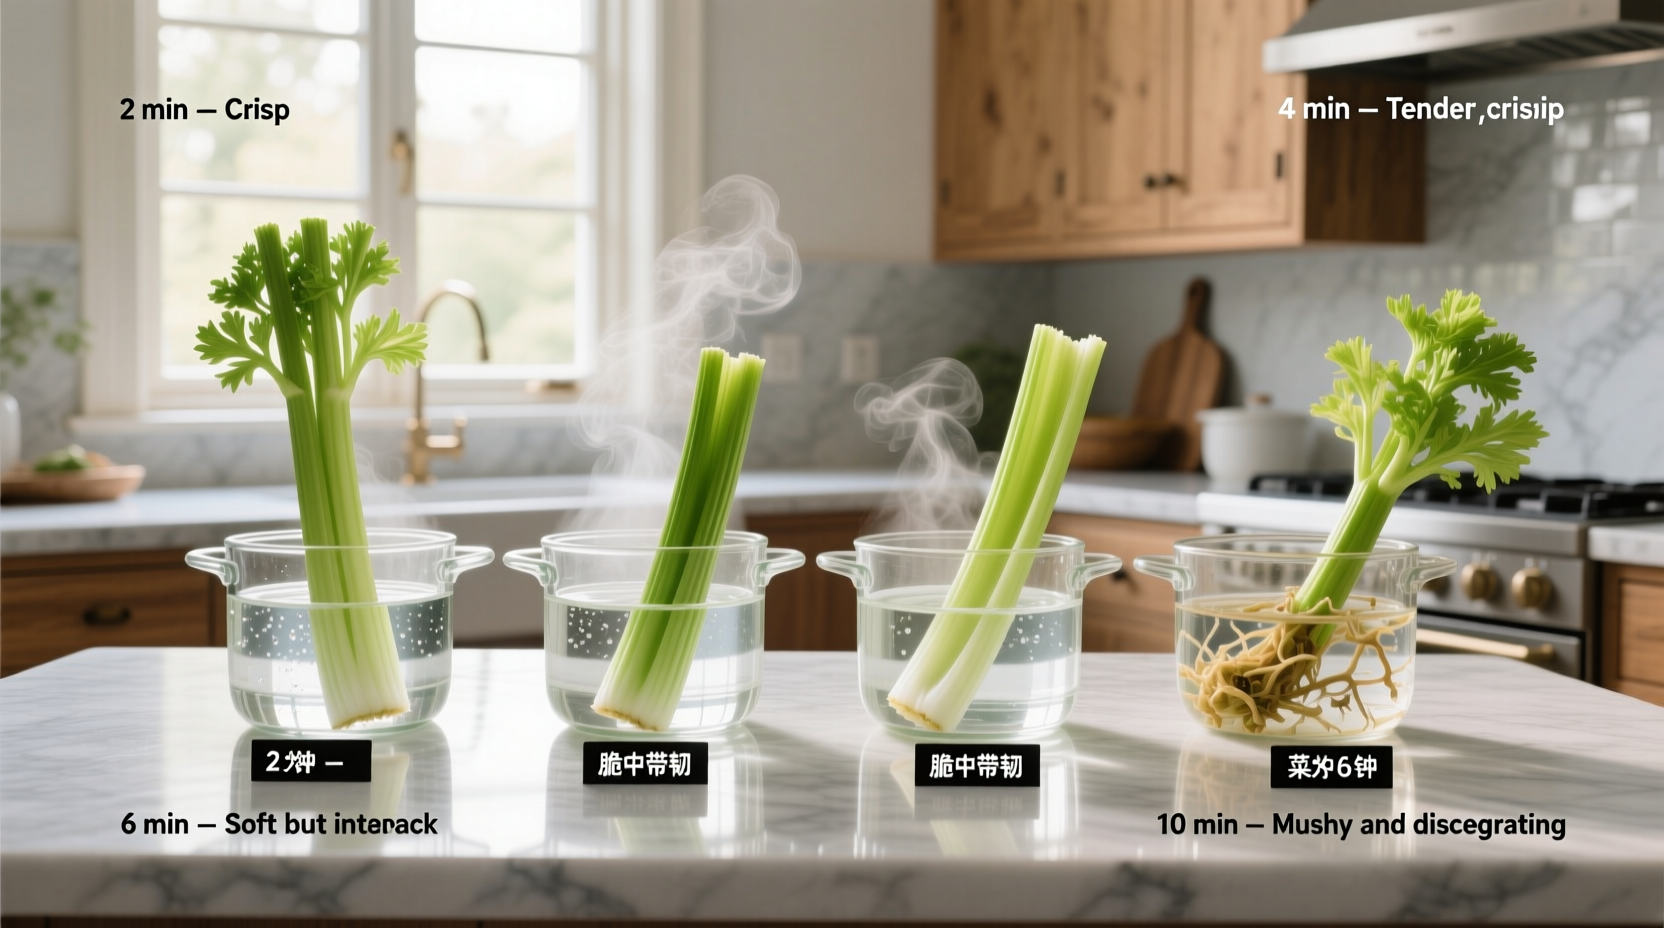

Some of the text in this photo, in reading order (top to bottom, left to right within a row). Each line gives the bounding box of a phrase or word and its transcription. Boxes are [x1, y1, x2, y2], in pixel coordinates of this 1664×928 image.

[597, 751, 691, 777] 脆中带韧
[929, 753, 1023, 779] 脆中带韧
